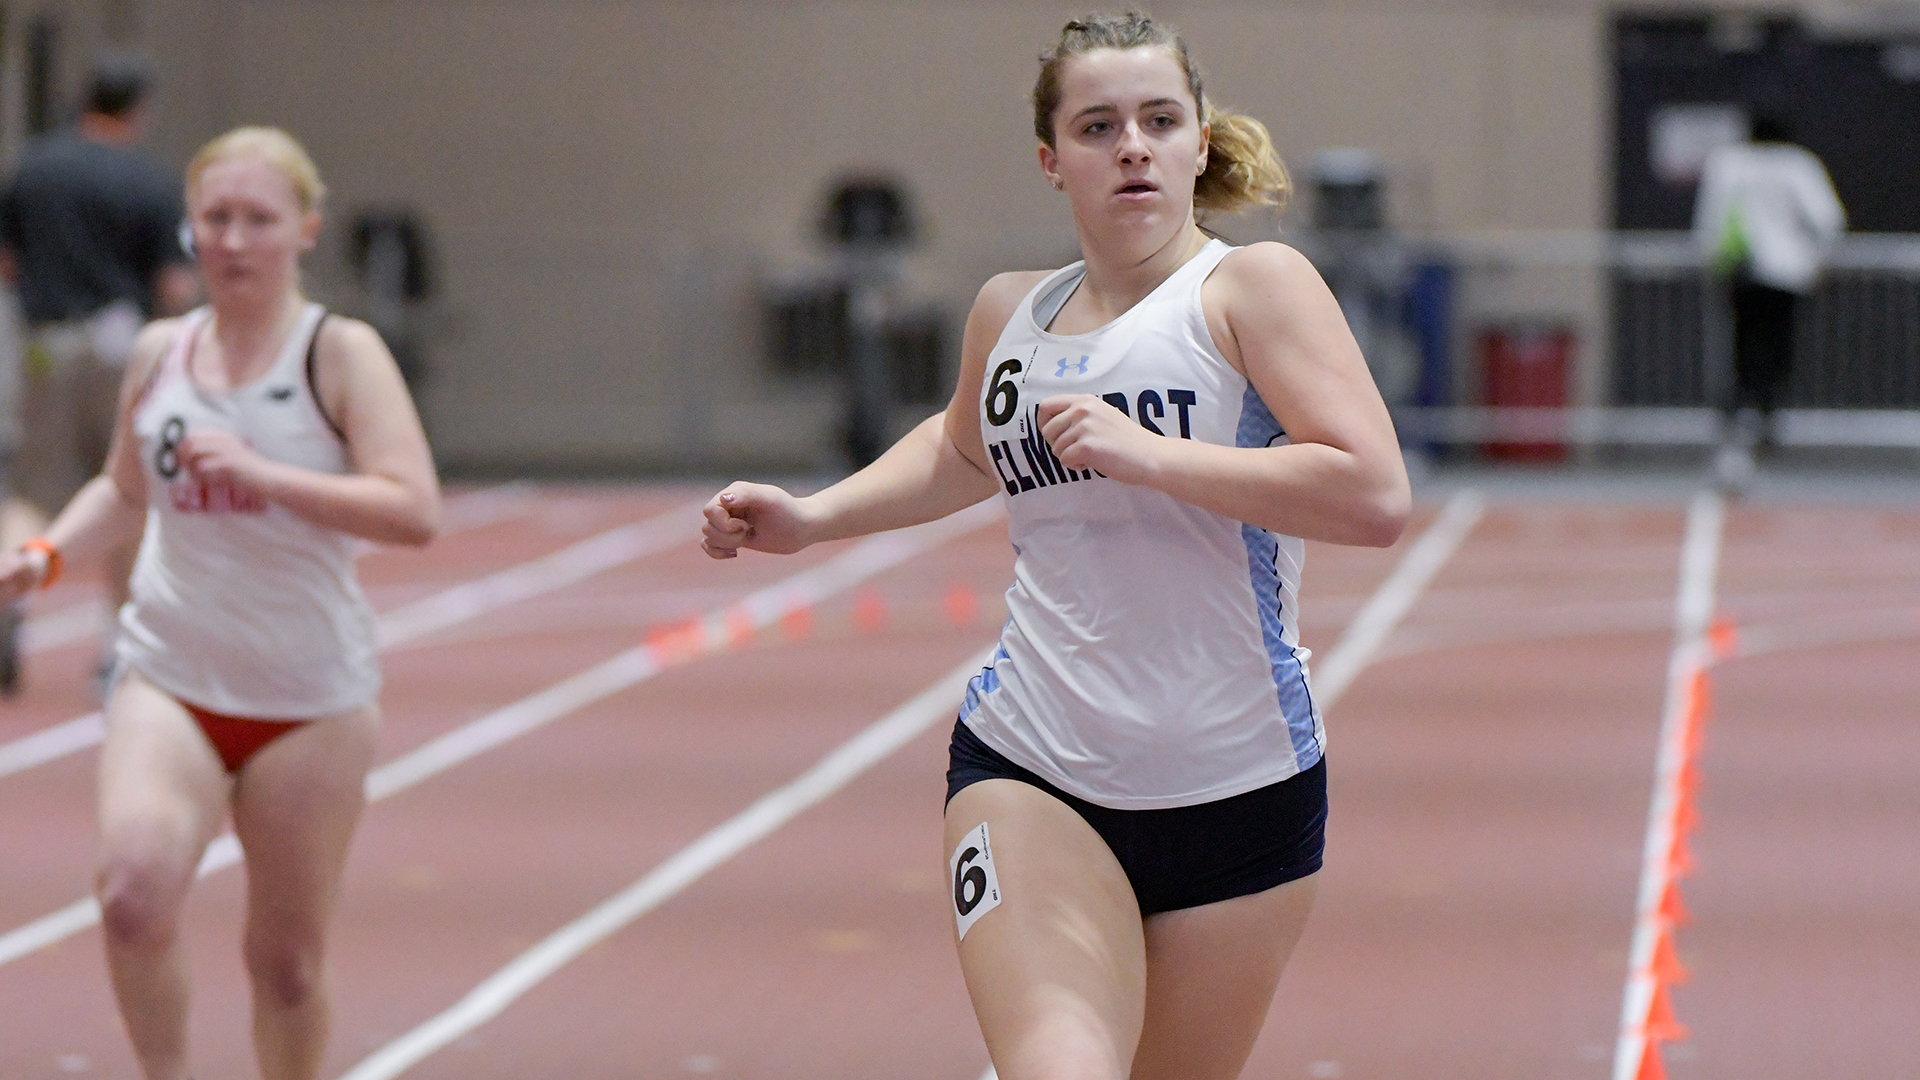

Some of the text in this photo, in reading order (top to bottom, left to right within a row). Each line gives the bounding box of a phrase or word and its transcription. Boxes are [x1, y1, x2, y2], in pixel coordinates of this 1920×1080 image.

[985, 359, 1022, 427] 6
[155, 416, 185, 480] 8
[988, 389, 1197, 497] ELMST
[955, 847, 987, 916] 6
